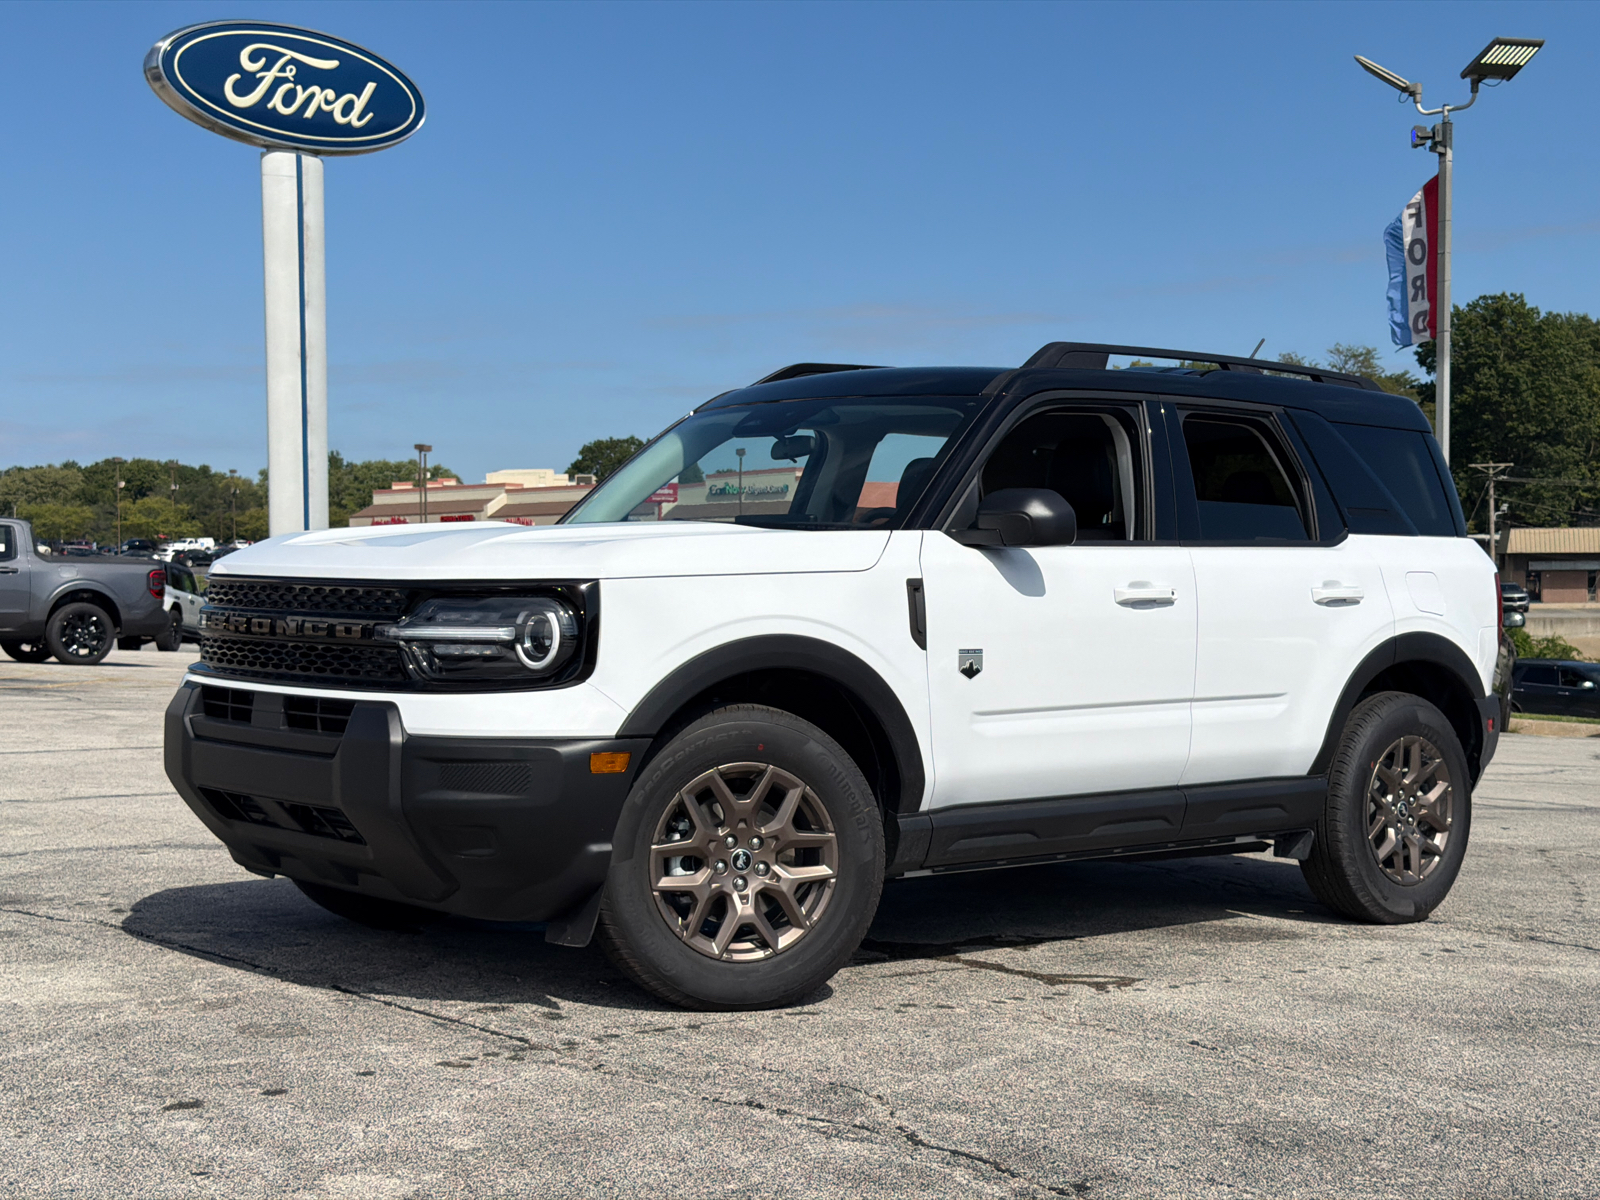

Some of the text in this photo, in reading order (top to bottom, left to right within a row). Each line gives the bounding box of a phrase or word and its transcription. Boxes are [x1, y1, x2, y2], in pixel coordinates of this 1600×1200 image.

[224, 43, 377, 128] Ford
[211, 614, 362, 639] BRONCO
[815, 752, 869, 831] Continental
